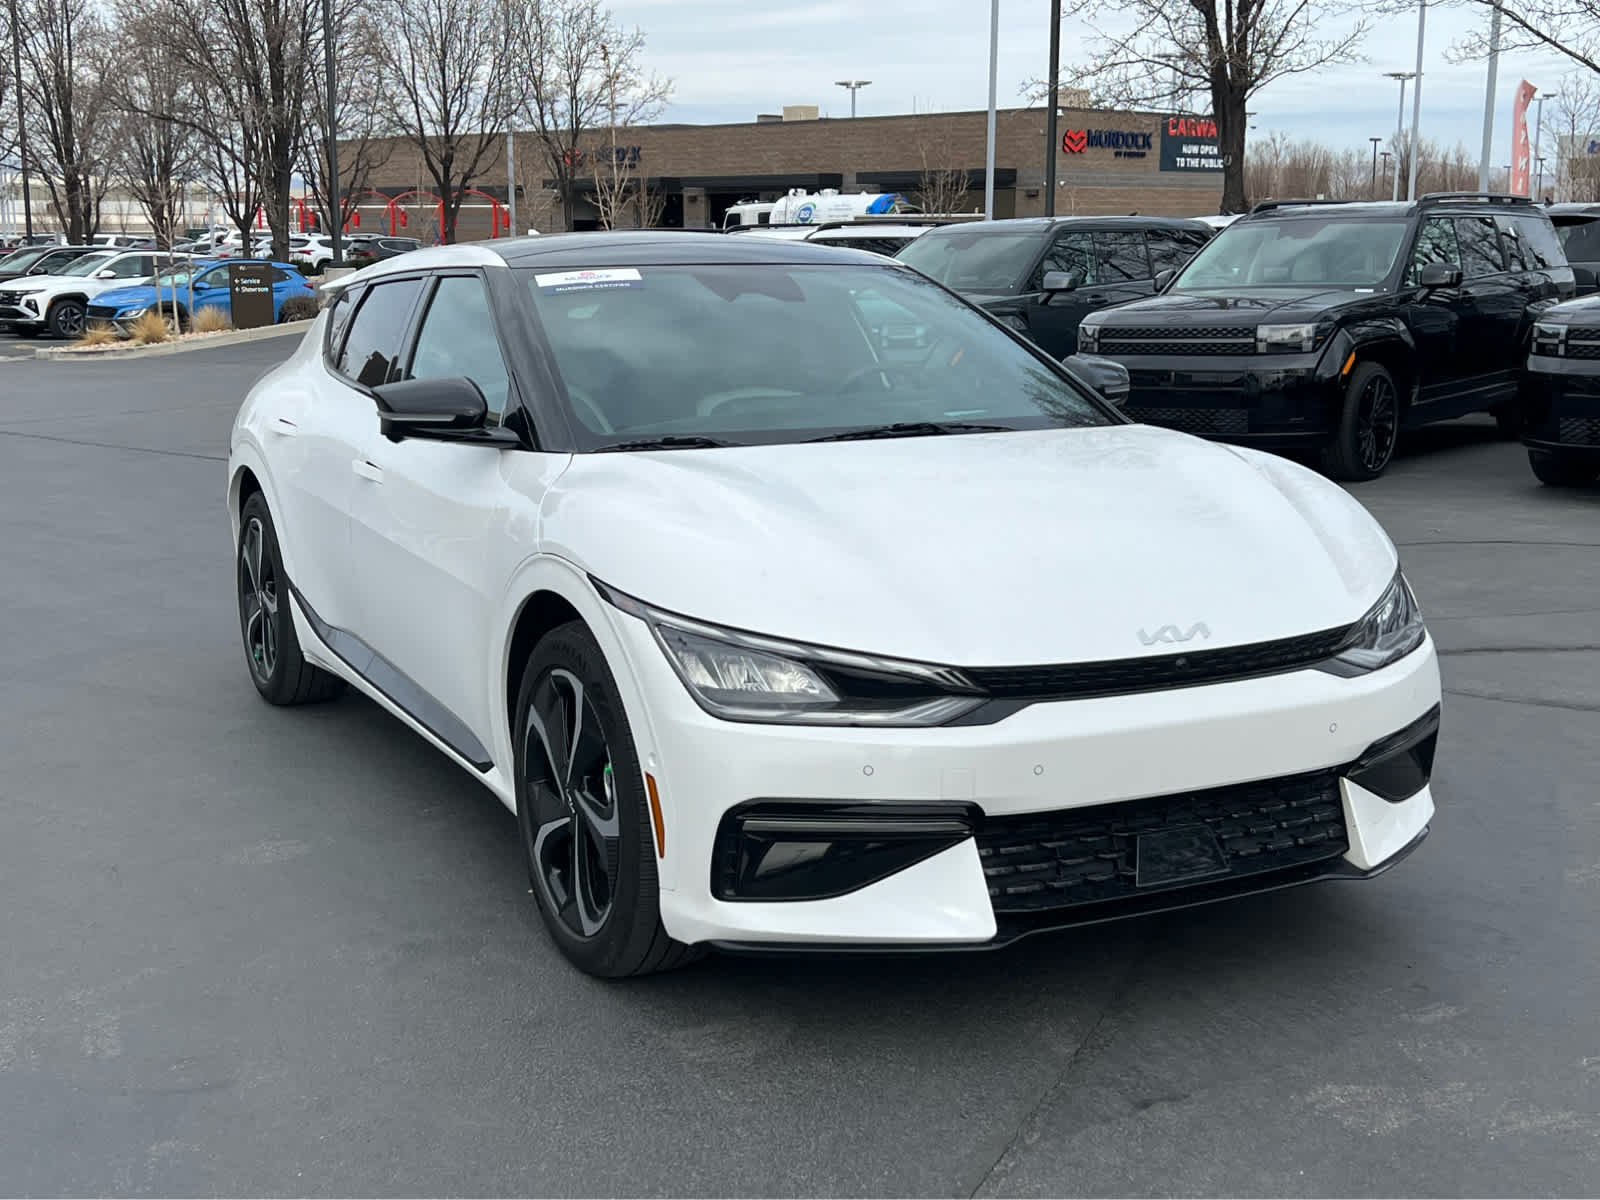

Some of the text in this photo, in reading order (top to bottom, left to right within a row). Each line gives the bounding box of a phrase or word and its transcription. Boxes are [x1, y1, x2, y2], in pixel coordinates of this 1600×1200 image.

[1168, 118, 1217, 137] CARWA
[1087, 129, 1152, 150] MURDOCK
[1182, 144, 1218, 155] NOW OPEN
[1176, 157, 1224, 168] TO THE PUBLIC
[1137, 620, 1210, 646] KIA
